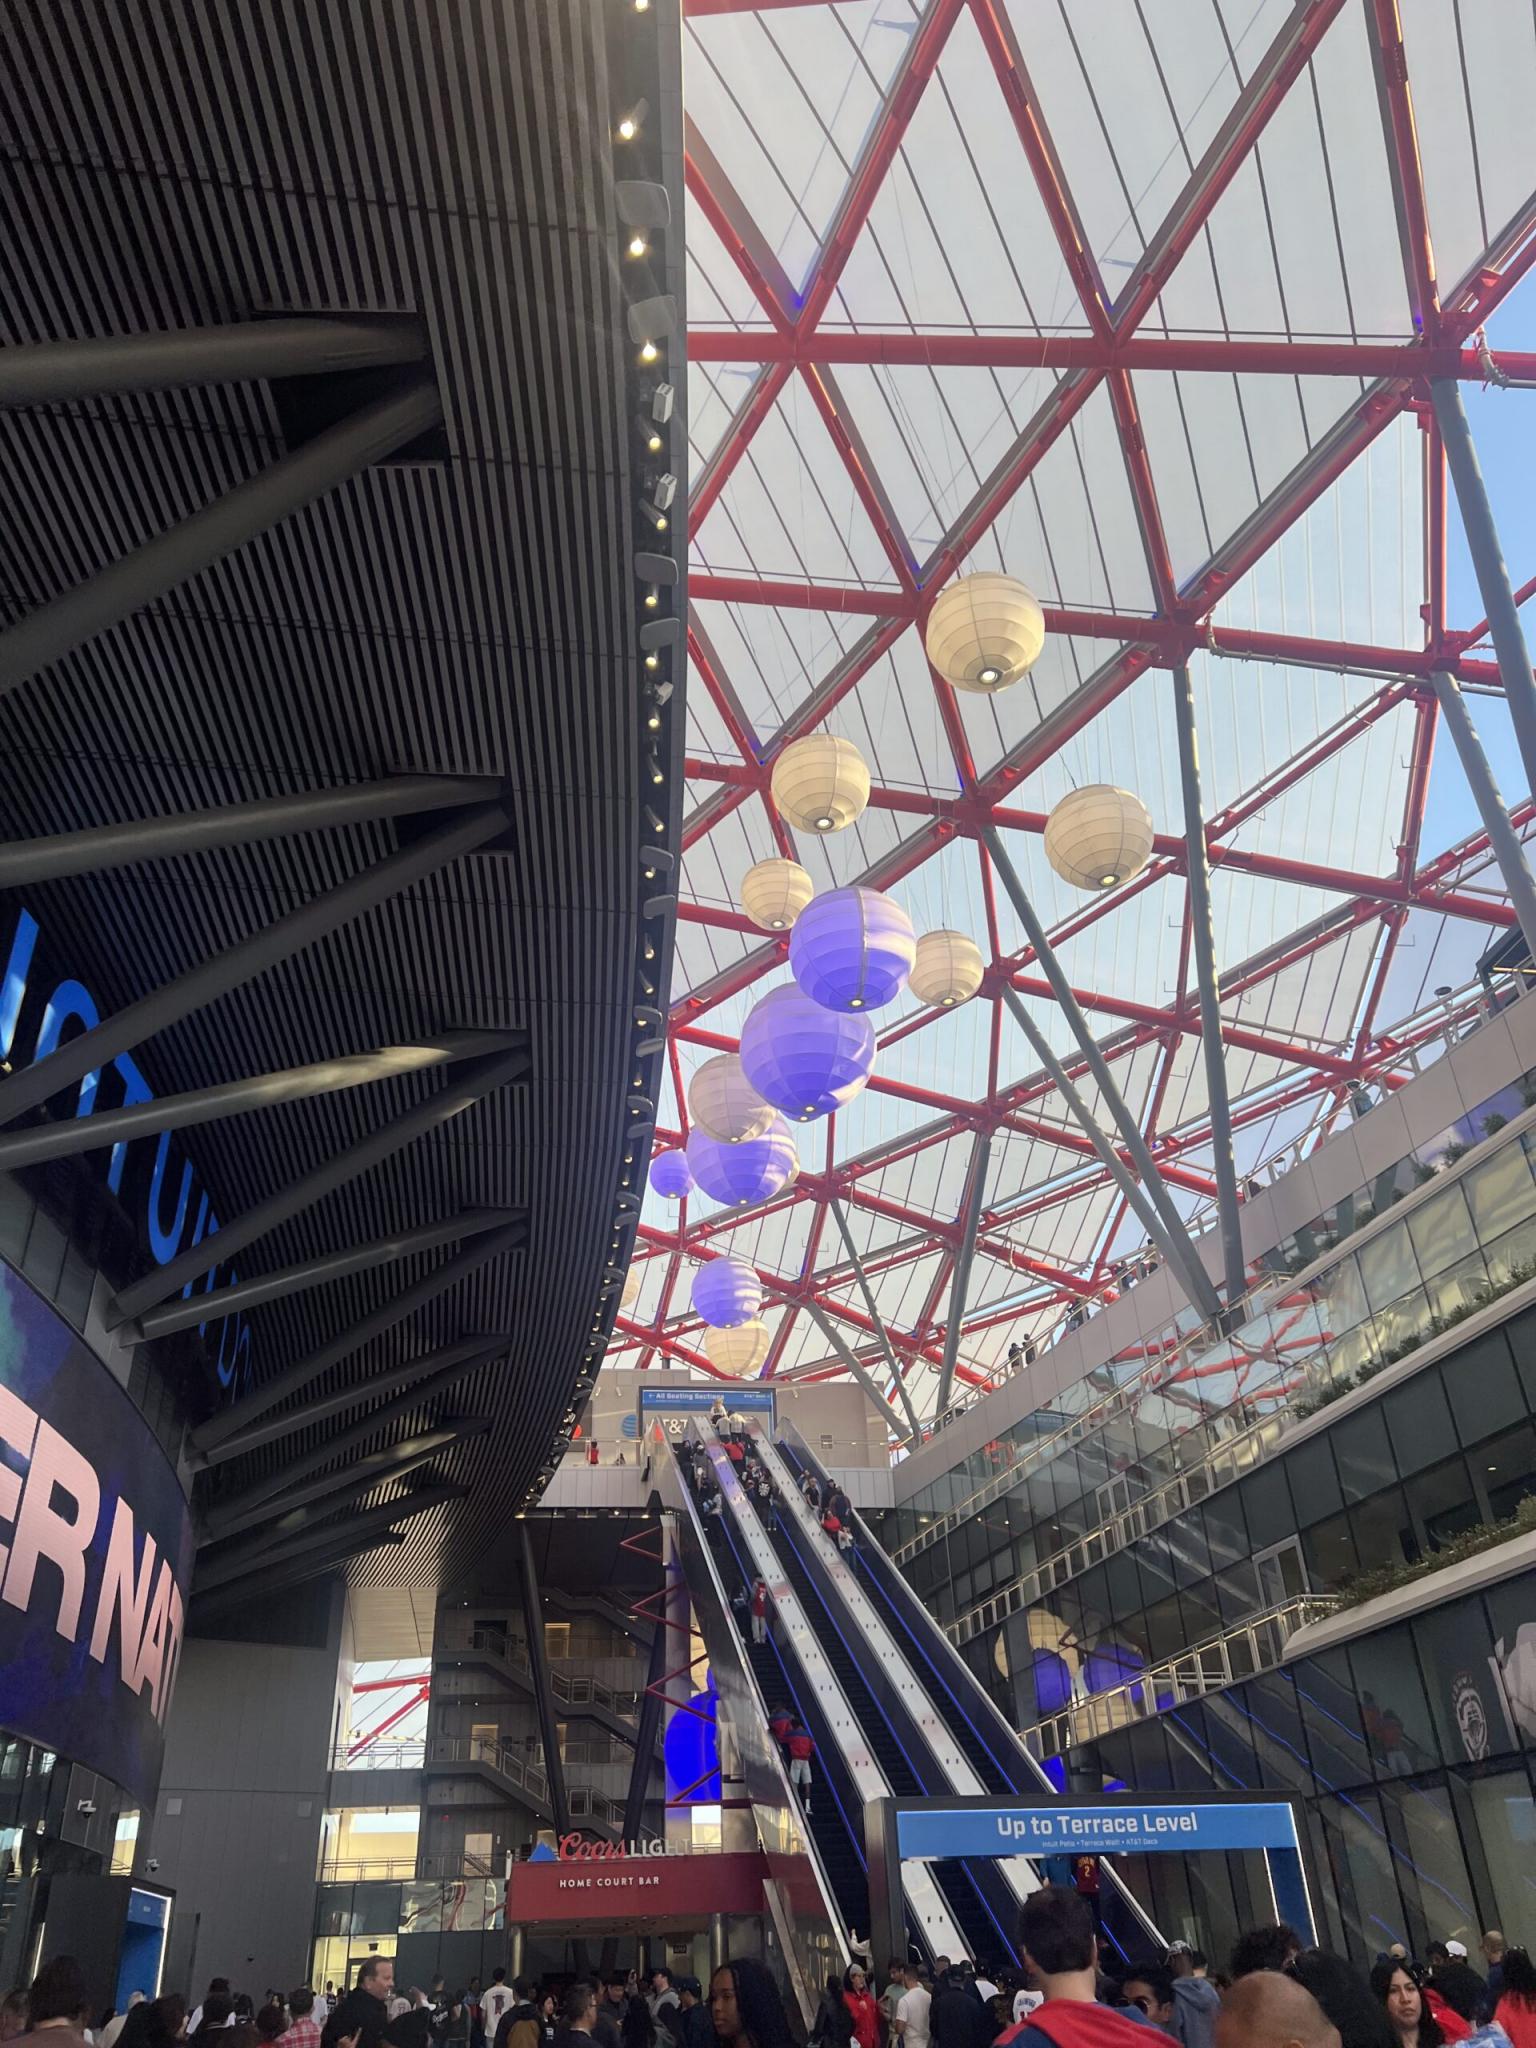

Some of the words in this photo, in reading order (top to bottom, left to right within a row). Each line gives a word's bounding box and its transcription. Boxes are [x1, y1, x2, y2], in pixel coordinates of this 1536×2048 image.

[656, 1392, 665, 1400] All
[998, 1816, 1026, 1839] Up
[1031, 1816, 1052, 1835] to
[1056, 1815, 1138, 1834] Terrace
[1142, 1812, 1198, 1832] Level
[559, 1831, 627, 1861] Coors
[630, 1838, 691, 1858] LIGHT
[1084, 1865, 1091, 1878] 2
[559, 1878, 592, 1888] HOME
[597, 1877, 634, 1887] COURT
[638, 1876, 660, 1886] BAR
